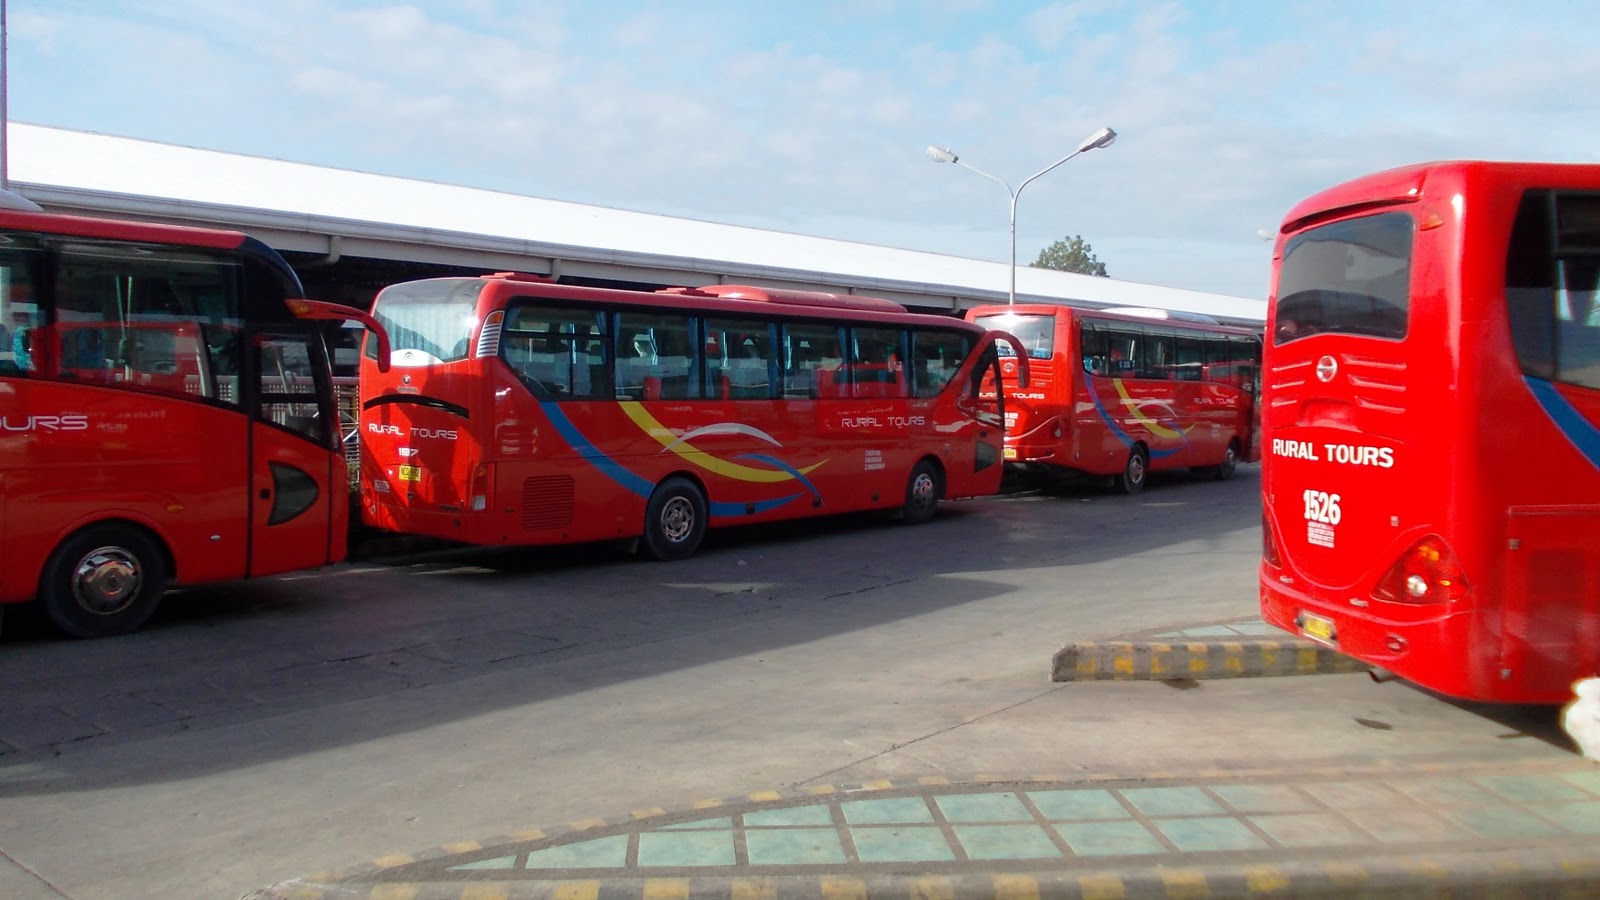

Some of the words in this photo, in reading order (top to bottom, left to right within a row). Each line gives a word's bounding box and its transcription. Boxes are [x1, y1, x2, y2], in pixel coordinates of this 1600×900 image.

[0, 415, 88, 431] URS
[841, 418, 883, 428] RURAL
[887, 416, 925, 426] TOURS
[369, 423, 404, 435] RURAL
[410, 427, 458, 440] TOURS
[1272, 438, 1319, 461] RURAL
[1324, 444, 1394, 468] TOURS
[1303, 489, 1341, 525] 1526
